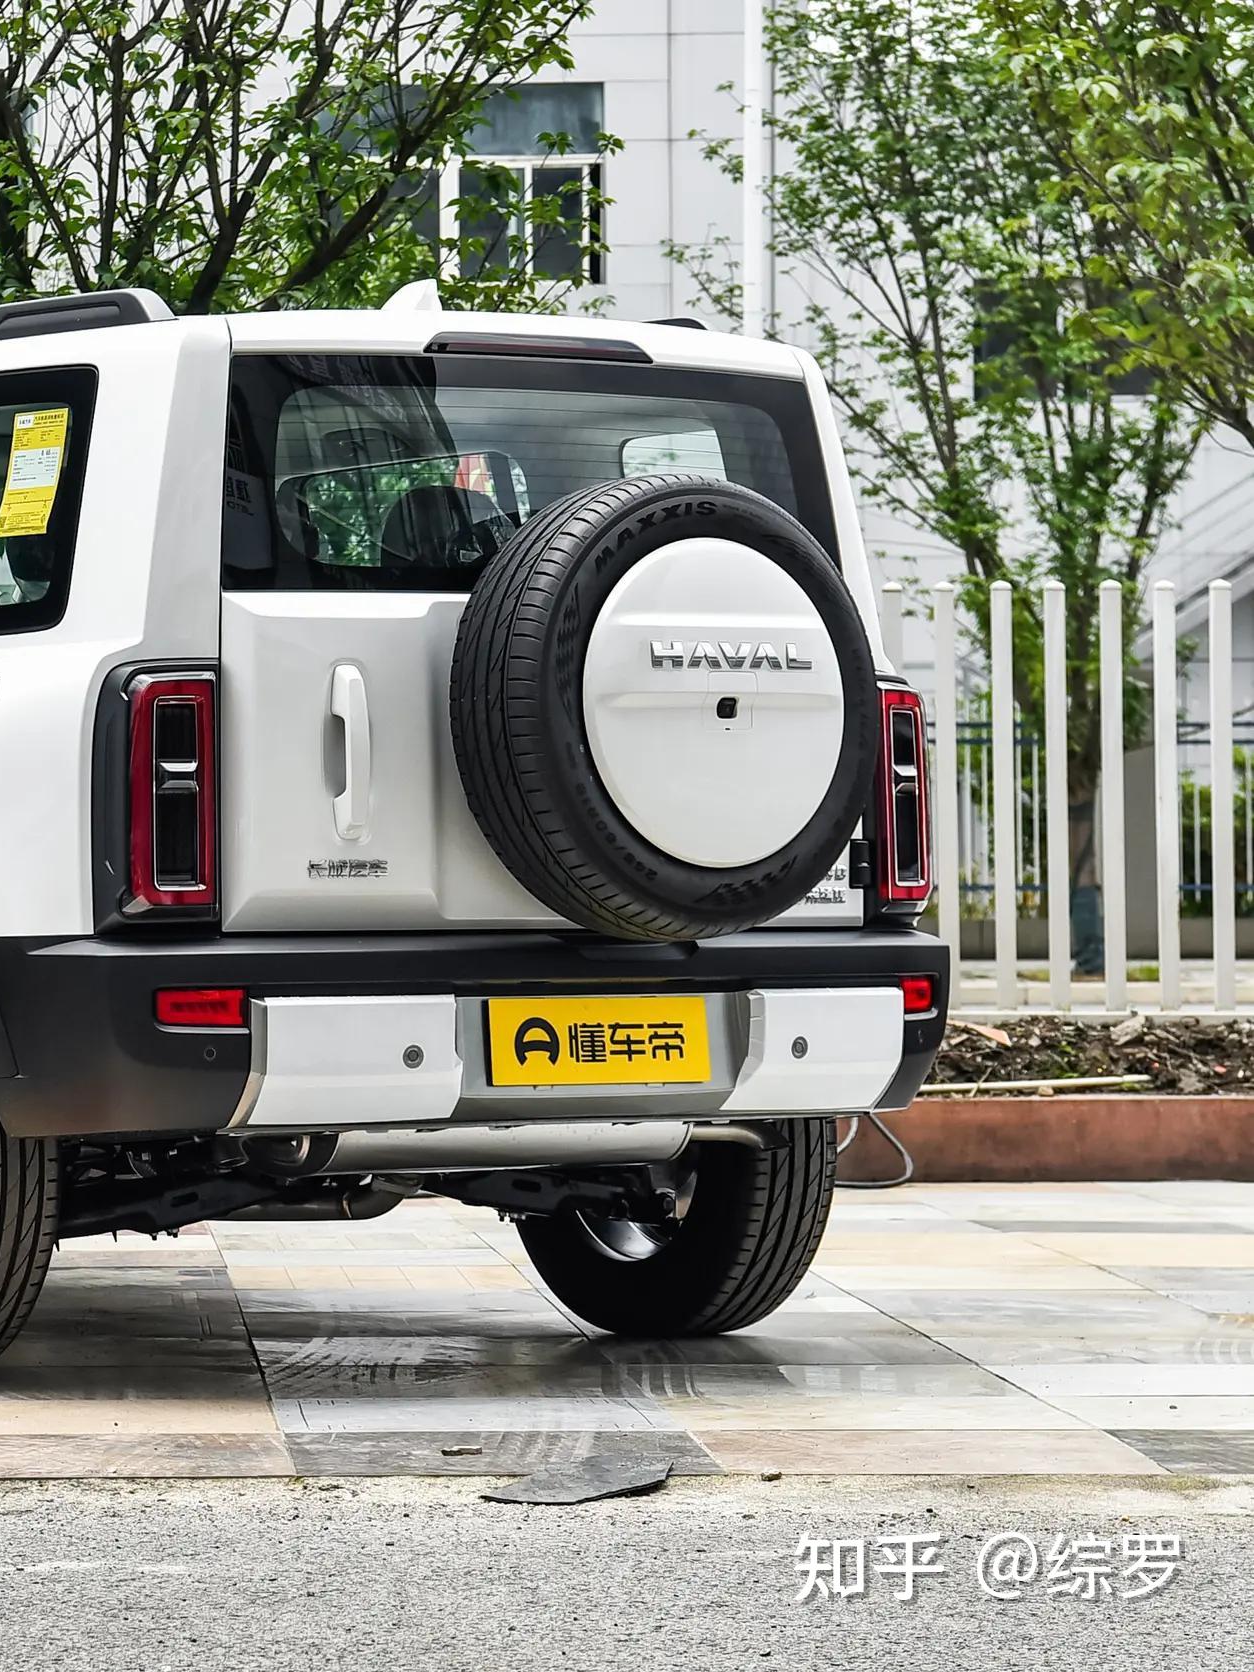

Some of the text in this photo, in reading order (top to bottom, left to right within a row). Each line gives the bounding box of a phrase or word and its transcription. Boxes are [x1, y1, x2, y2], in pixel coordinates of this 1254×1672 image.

[594, 501, 718, 574] MAXXIS
[649, 640, 814, 671] HAVAL
[568, 1021, 686, 1064] 懂车帝
